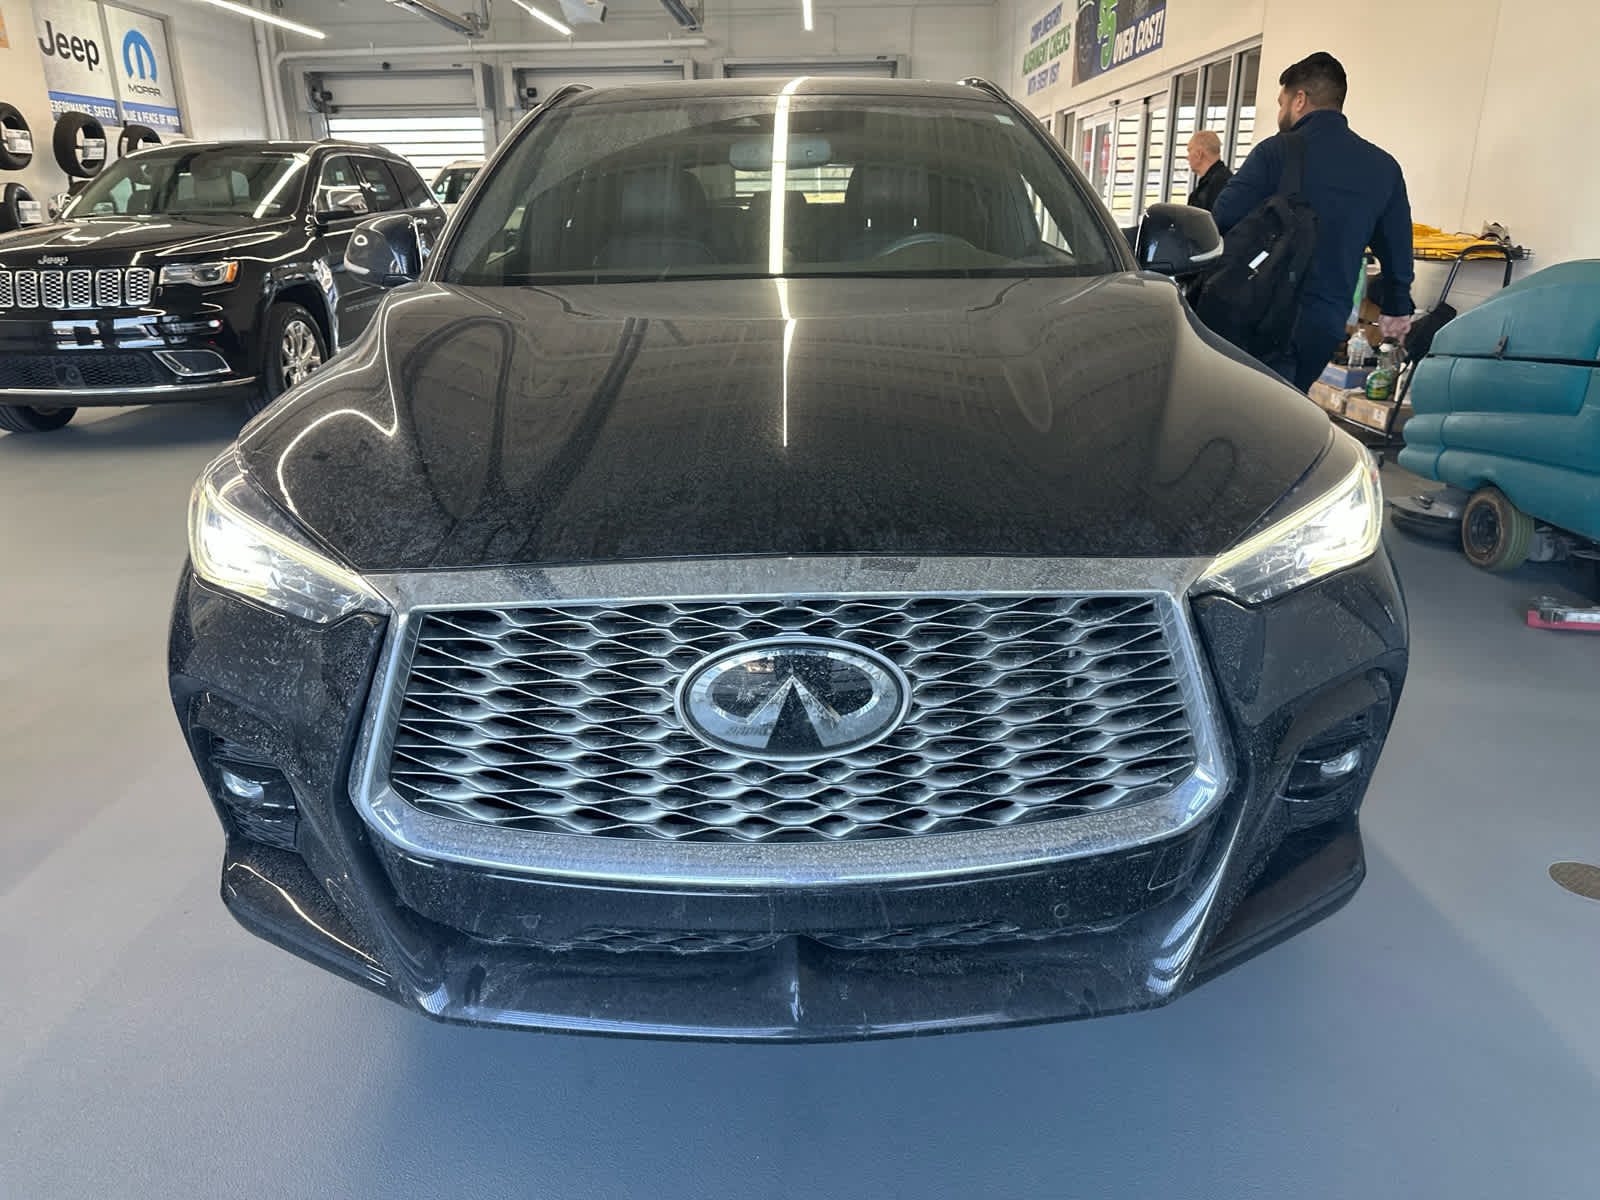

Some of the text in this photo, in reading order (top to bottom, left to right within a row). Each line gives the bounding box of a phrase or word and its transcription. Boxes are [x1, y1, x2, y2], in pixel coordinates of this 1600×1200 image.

[38, 20, 100, 71] Jeep
[1113, 25, 1136, 64] OVER
[1135, 9, 1165, 54] COST!
[128, 83, 160, 97] MOPAR
[37, 255, 69, 266] Jeep
